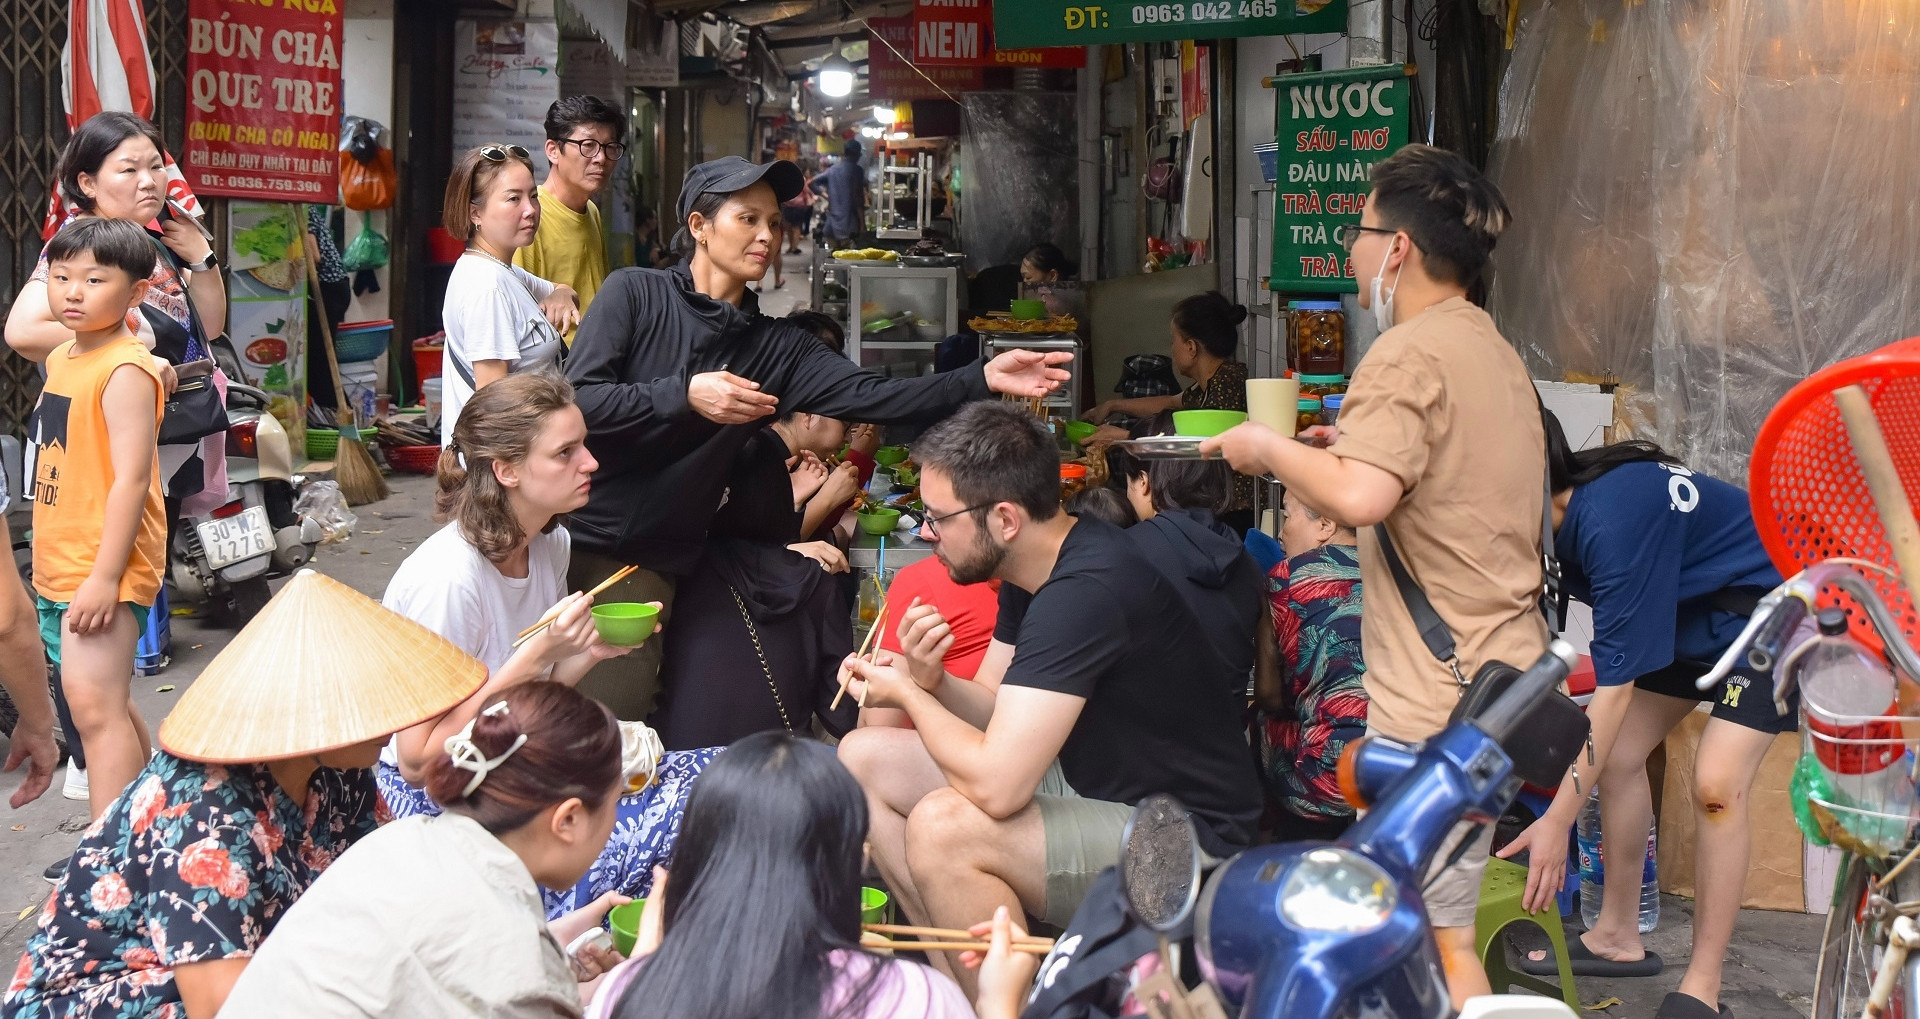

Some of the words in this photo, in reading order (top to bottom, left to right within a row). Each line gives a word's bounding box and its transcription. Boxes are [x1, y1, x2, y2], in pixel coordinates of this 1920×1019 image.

[1064, 6, 1109, 30] ĐT:
[1132, 4, 1185, 24] 0963
[1192, 1, 1231, 20] 042
[1238, 0, 1277, 18] 465
[190, 11, 264, 61] BÚN
[272, 21, 340, 70] CHẢ
[919, 21, 978, 58] NEM
[192, 69, 263, 113] QUE
[271, 77, 334, 116] TRE
[1296, 125, 1336, 152] SẤU
[1352, 126, 1389, 151] MƠ
[228, 176, 321, 192] 0936.759.390
[1288, 160, 1330, 187] ĐẬU
[1282, 189, 1322, 214] TRÀ
[1290, 222, 1327, 244] TRÀ
[1300, 253, 1340, 277] TRÀ
[218, 533, 265, 561] 4276
[1722, 683, 1743, 707] M
